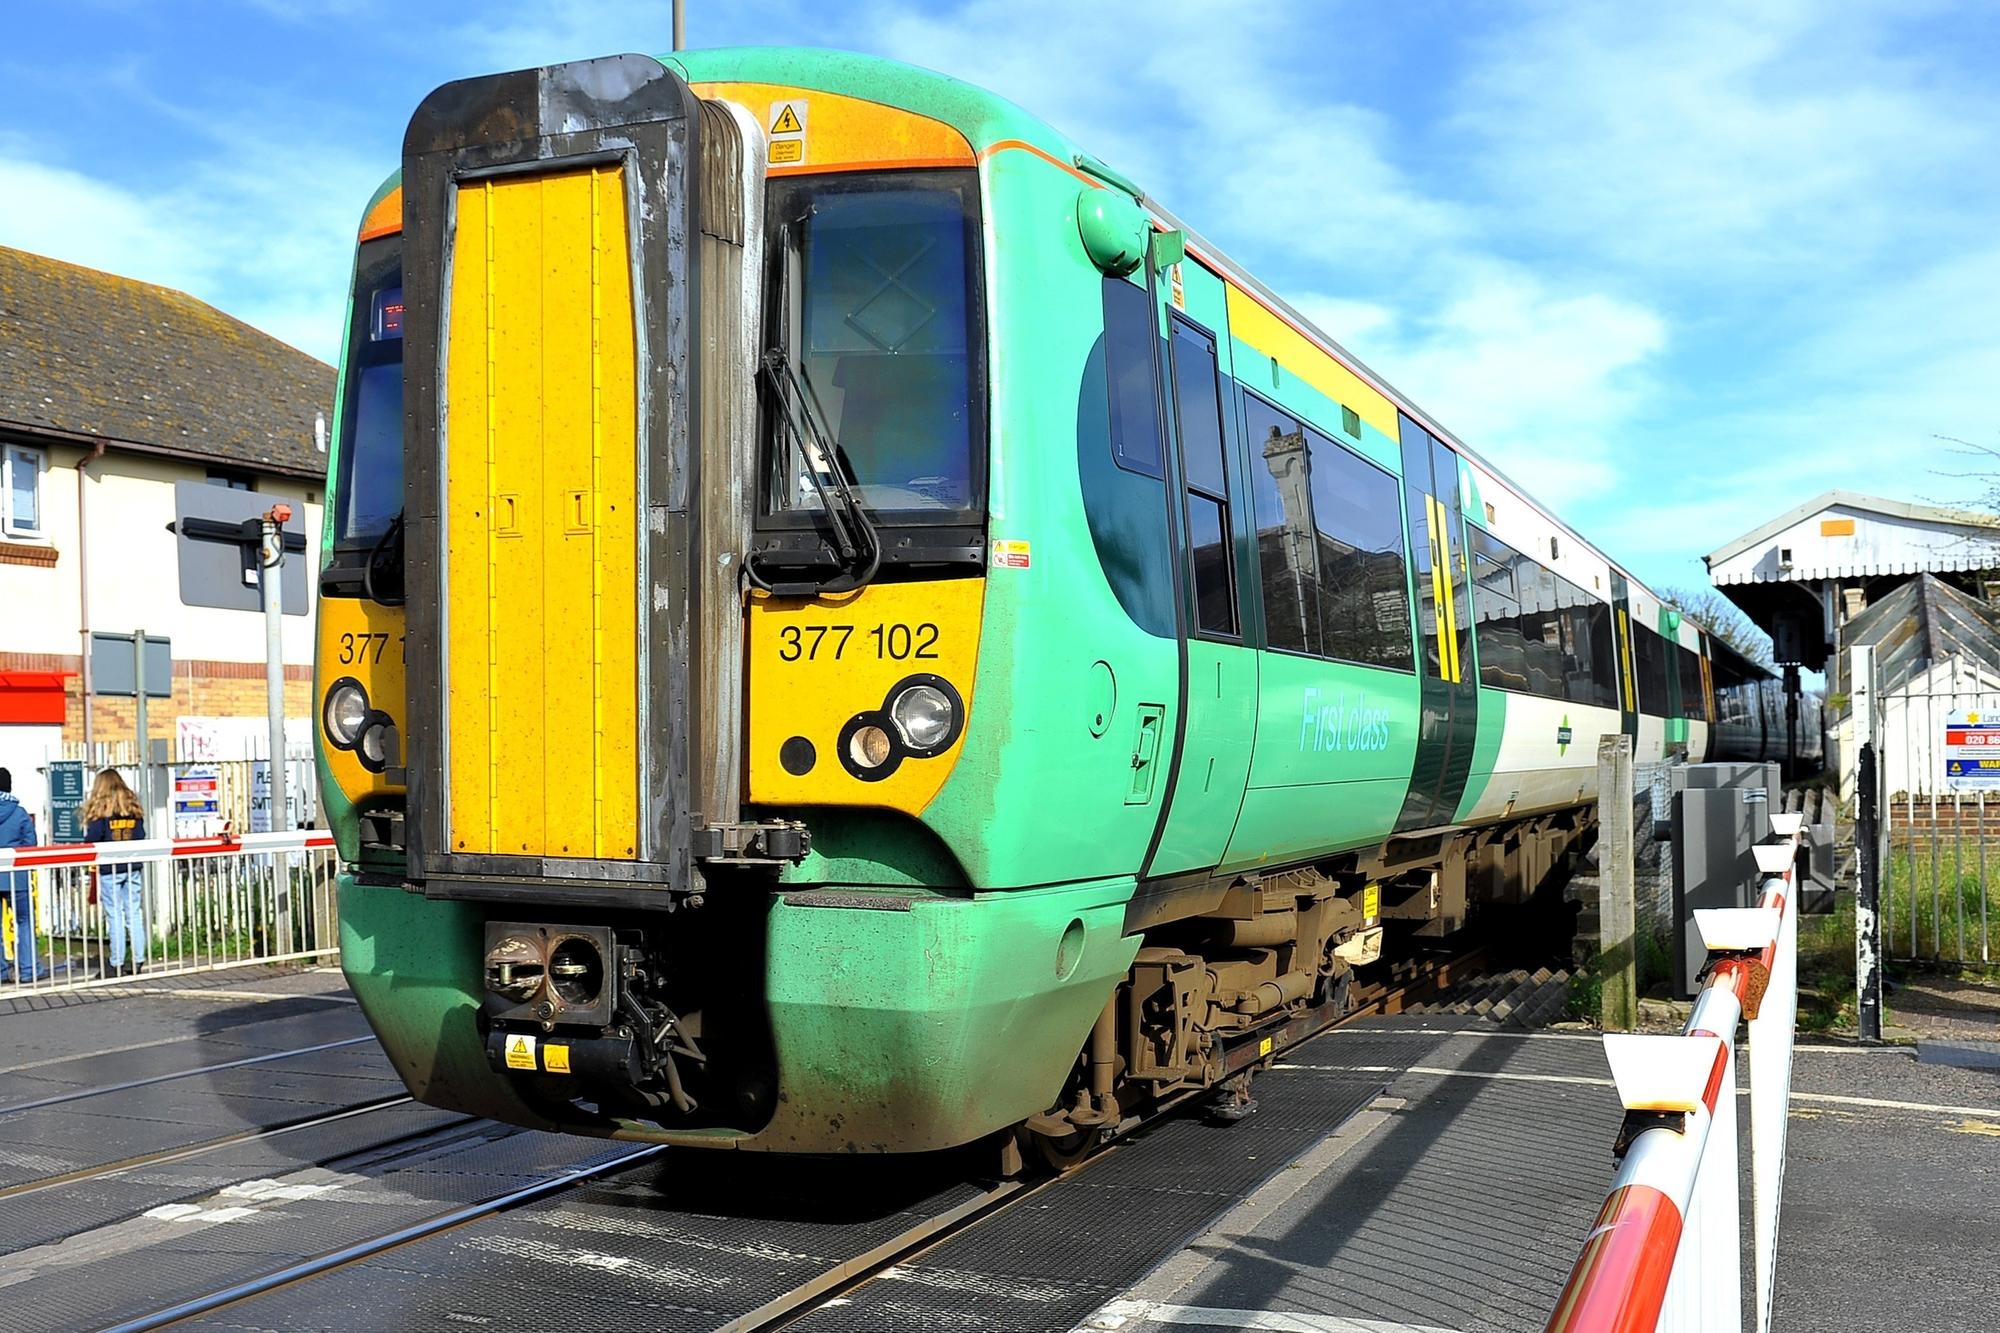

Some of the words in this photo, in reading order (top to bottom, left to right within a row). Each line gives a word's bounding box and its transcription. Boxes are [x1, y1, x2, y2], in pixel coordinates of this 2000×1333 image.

[339, 632, 389, 664] 377
[779, 625, 854, 661] 377
[870, 623, 939, 660] 102
[1299, 687, 1344, 752] First
[1347, 688, 1389, 752] class
[1965, 735, 1985, 745] 020
